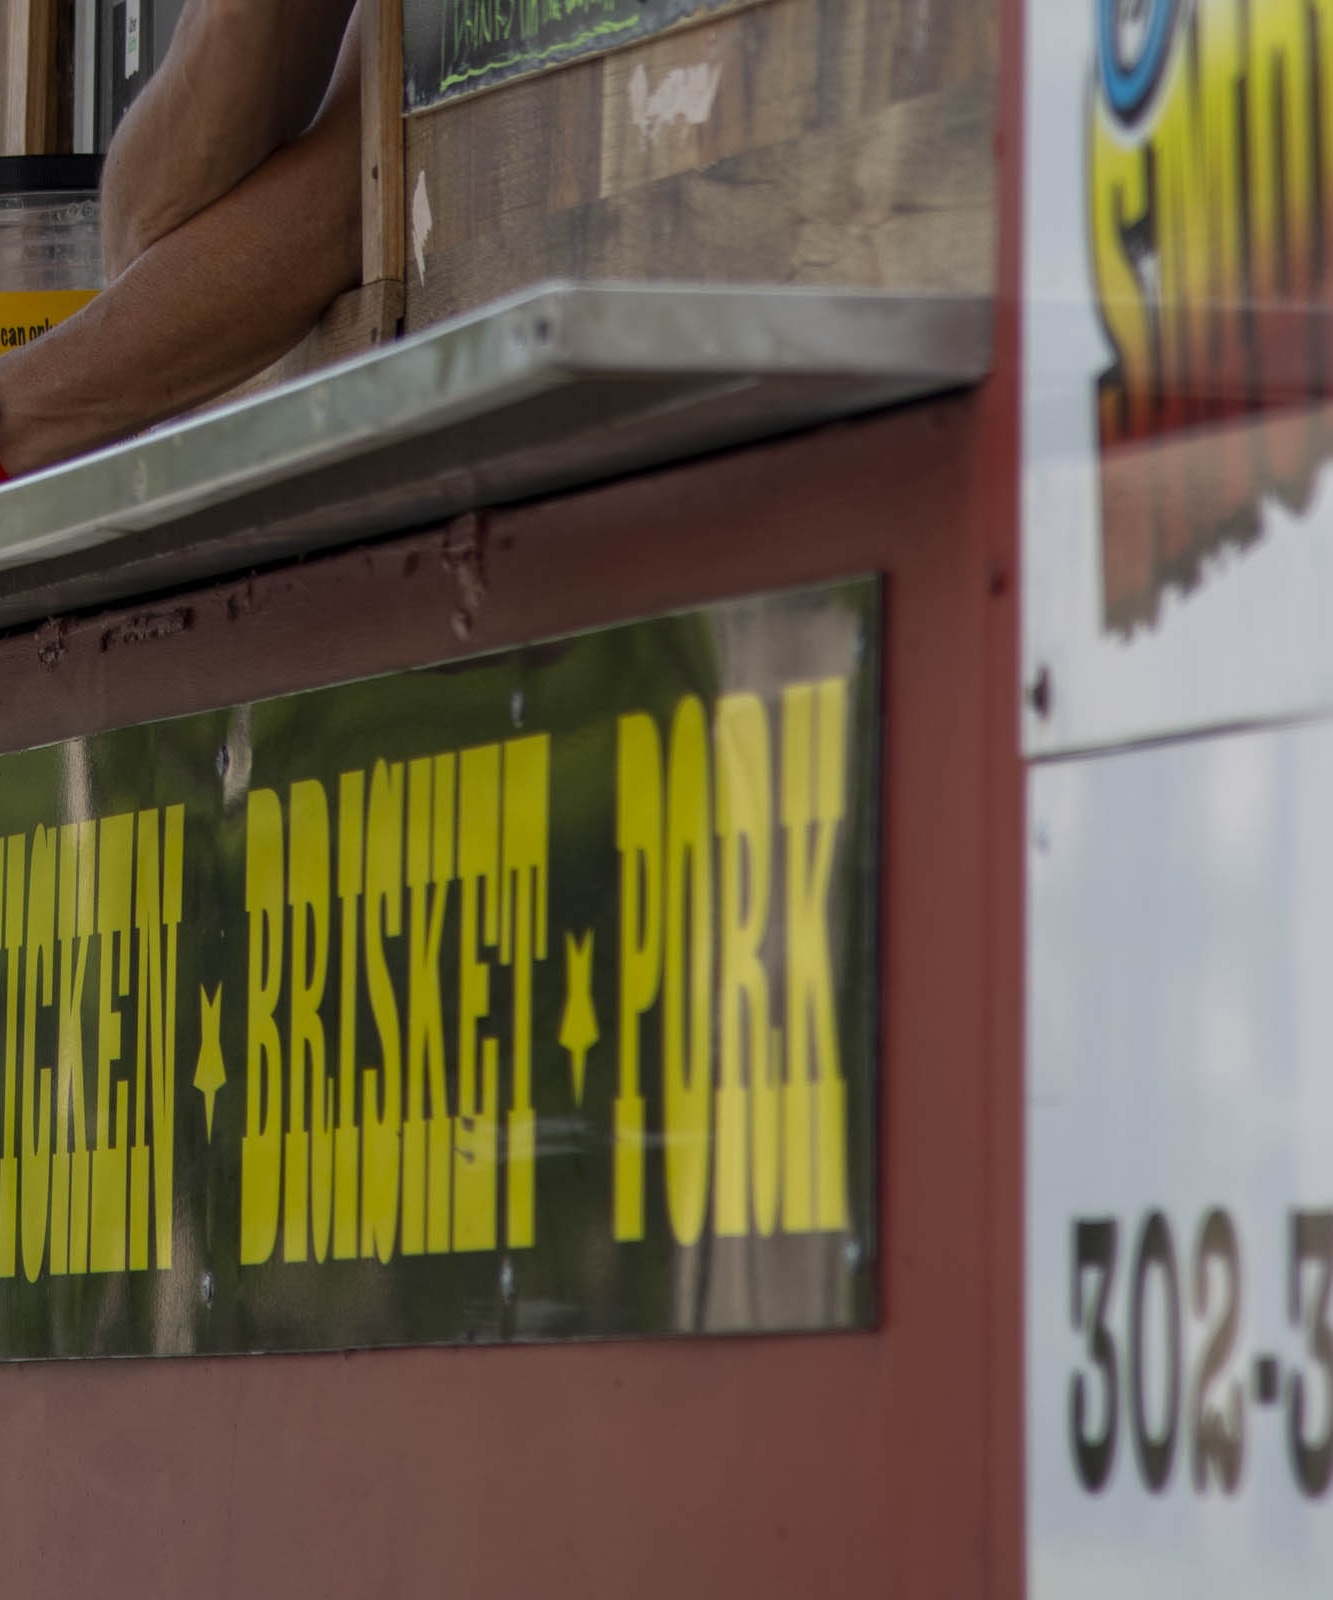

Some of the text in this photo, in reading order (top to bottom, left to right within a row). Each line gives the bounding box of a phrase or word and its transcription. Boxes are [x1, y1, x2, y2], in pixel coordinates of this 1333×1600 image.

[0, 327, 26, 347] can
[29, 317, 53, 341] onl
[240, 734, 551, 1266] BRISKET
[613, 677, 849, 1248] PORK
